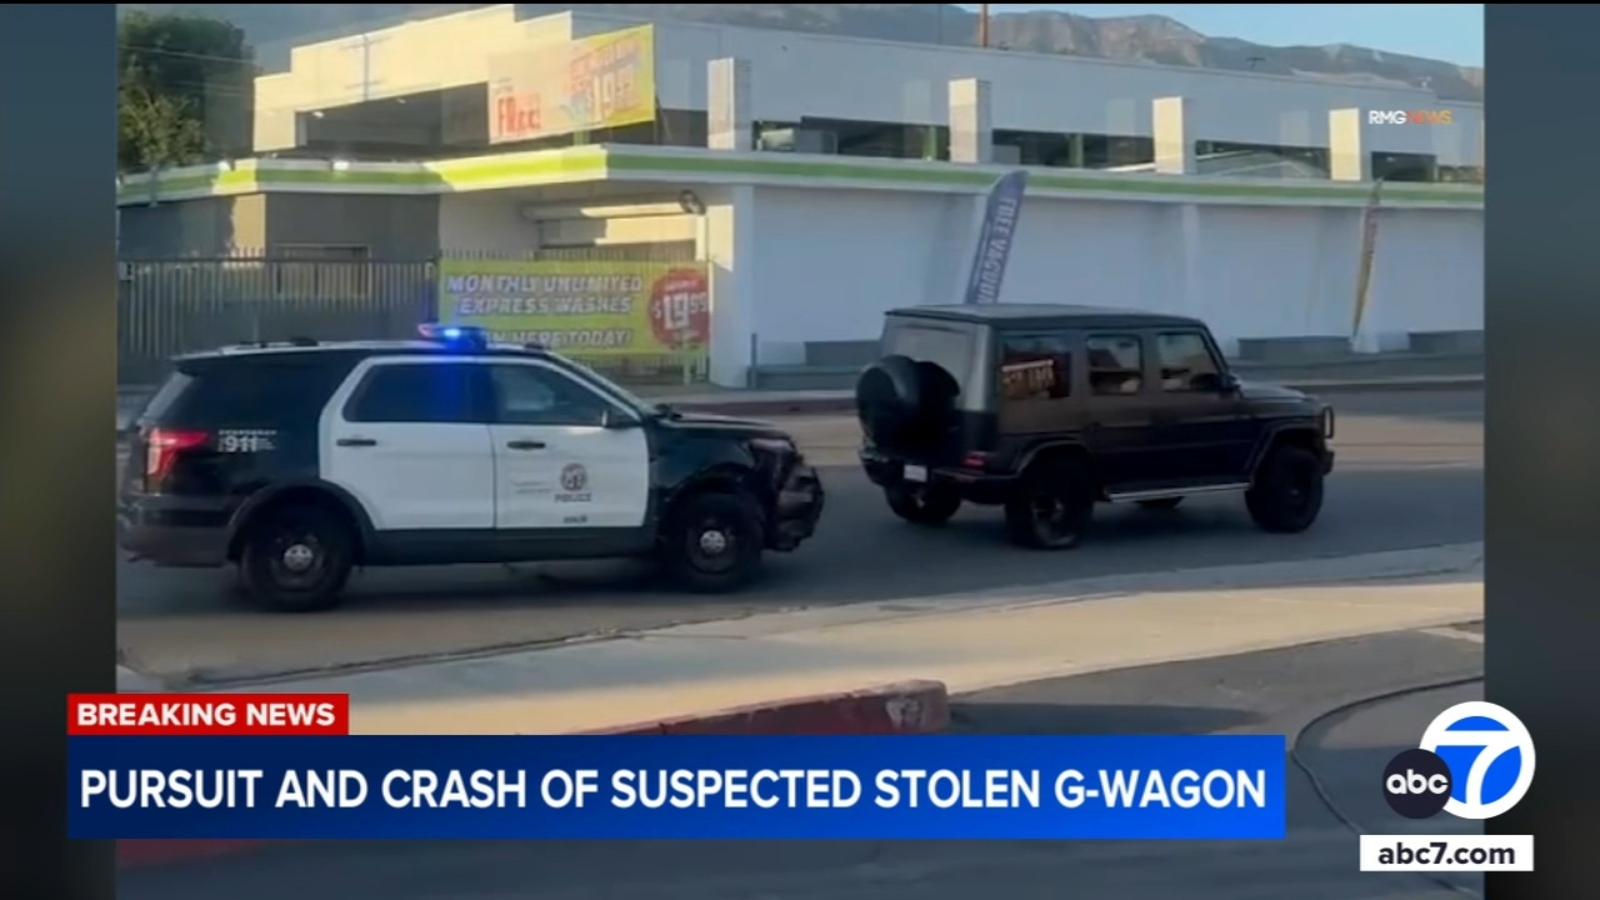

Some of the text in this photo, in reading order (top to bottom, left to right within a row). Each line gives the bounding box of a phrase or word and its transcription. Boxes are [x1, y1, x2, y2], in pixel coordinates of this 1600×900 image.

[993, 198, 1018, 236] FREE
[447, 274, 541, 293] MONTHLY
[544, 275, 643, 293] UNLIMITED
[460, 296, 632, 315] EXPRESS WASHES
[514, 330, 563, 346] HERE
[225, 435, 257, 453] 911
